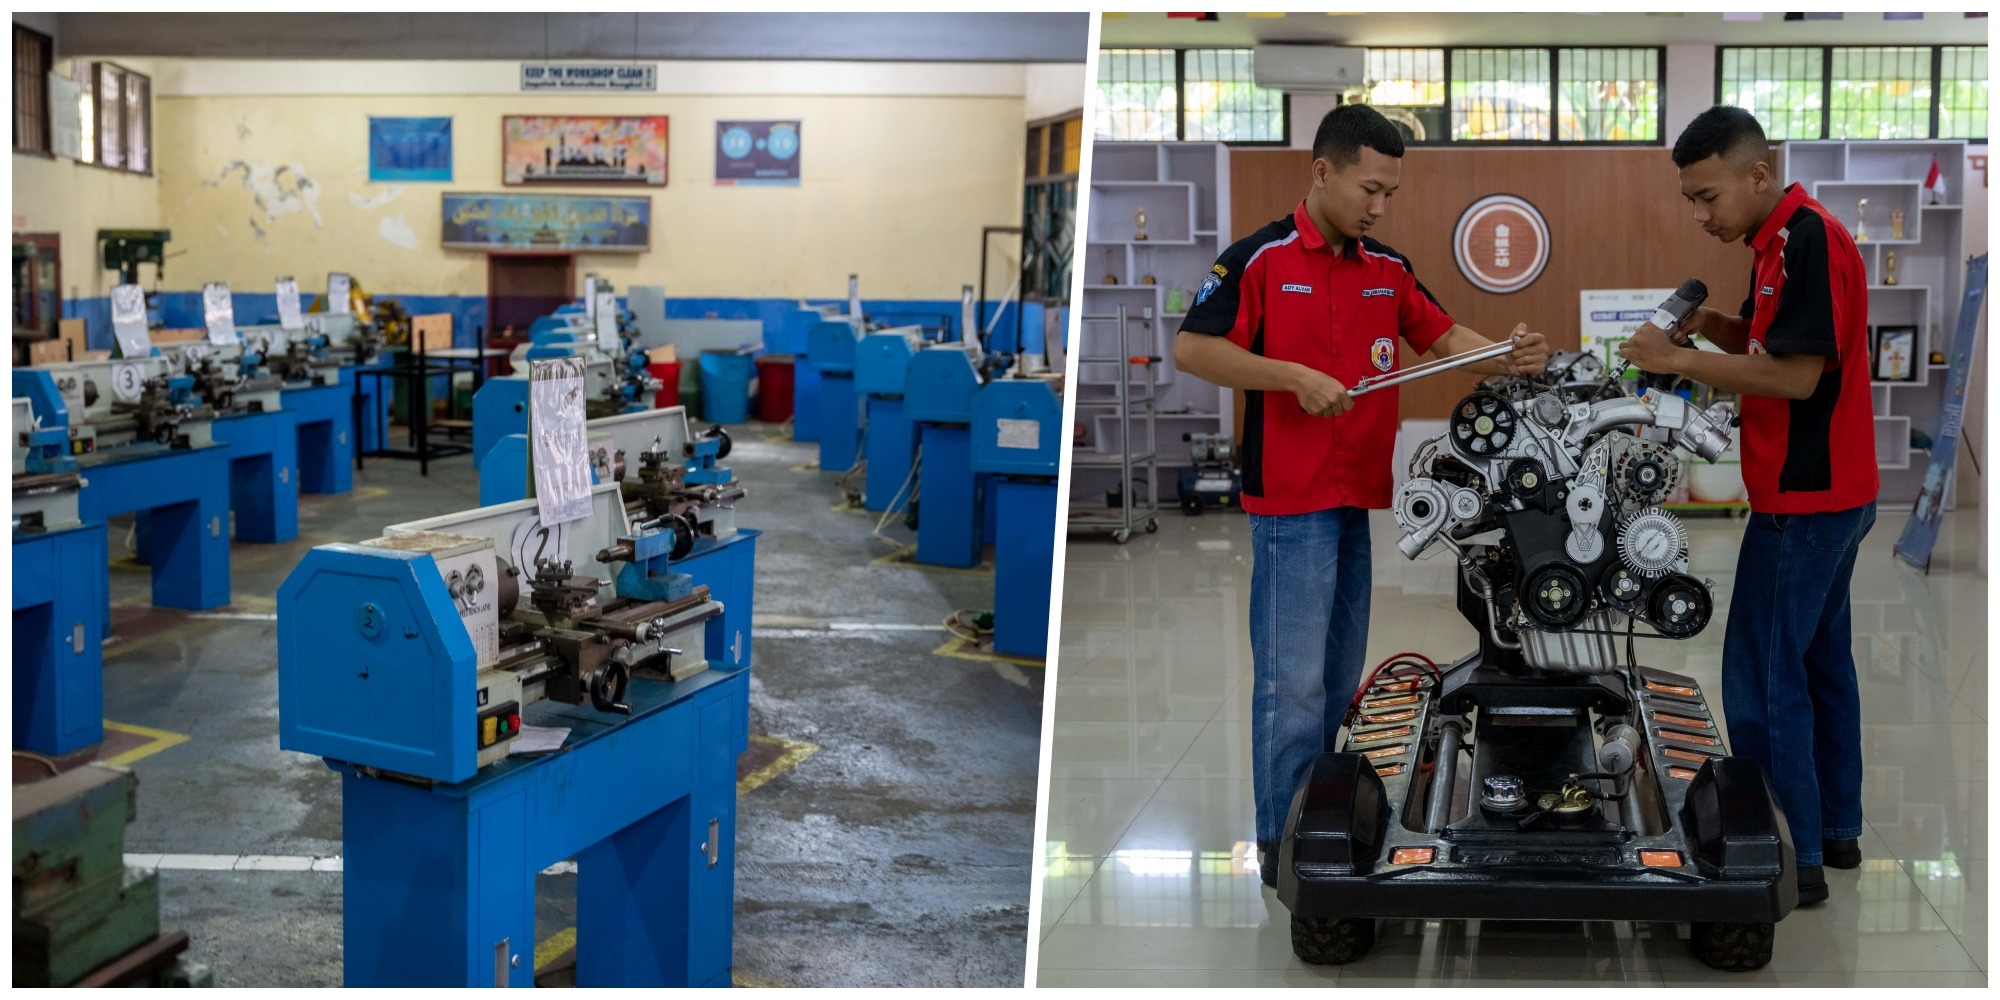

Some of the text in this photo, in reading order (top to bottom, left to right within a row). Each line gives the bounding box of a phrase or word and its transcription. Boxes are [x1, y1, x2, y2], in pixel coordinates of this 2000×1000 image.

[548, 67, 563, 78] THE
[566, 67, 614, 78] WORKSHOP
[617, 67, 643, 79] CLEAN
[124, 370, 134, 390] 3
[533, 527, 550, 566] 2
[363, 615, 374, 630] 2
